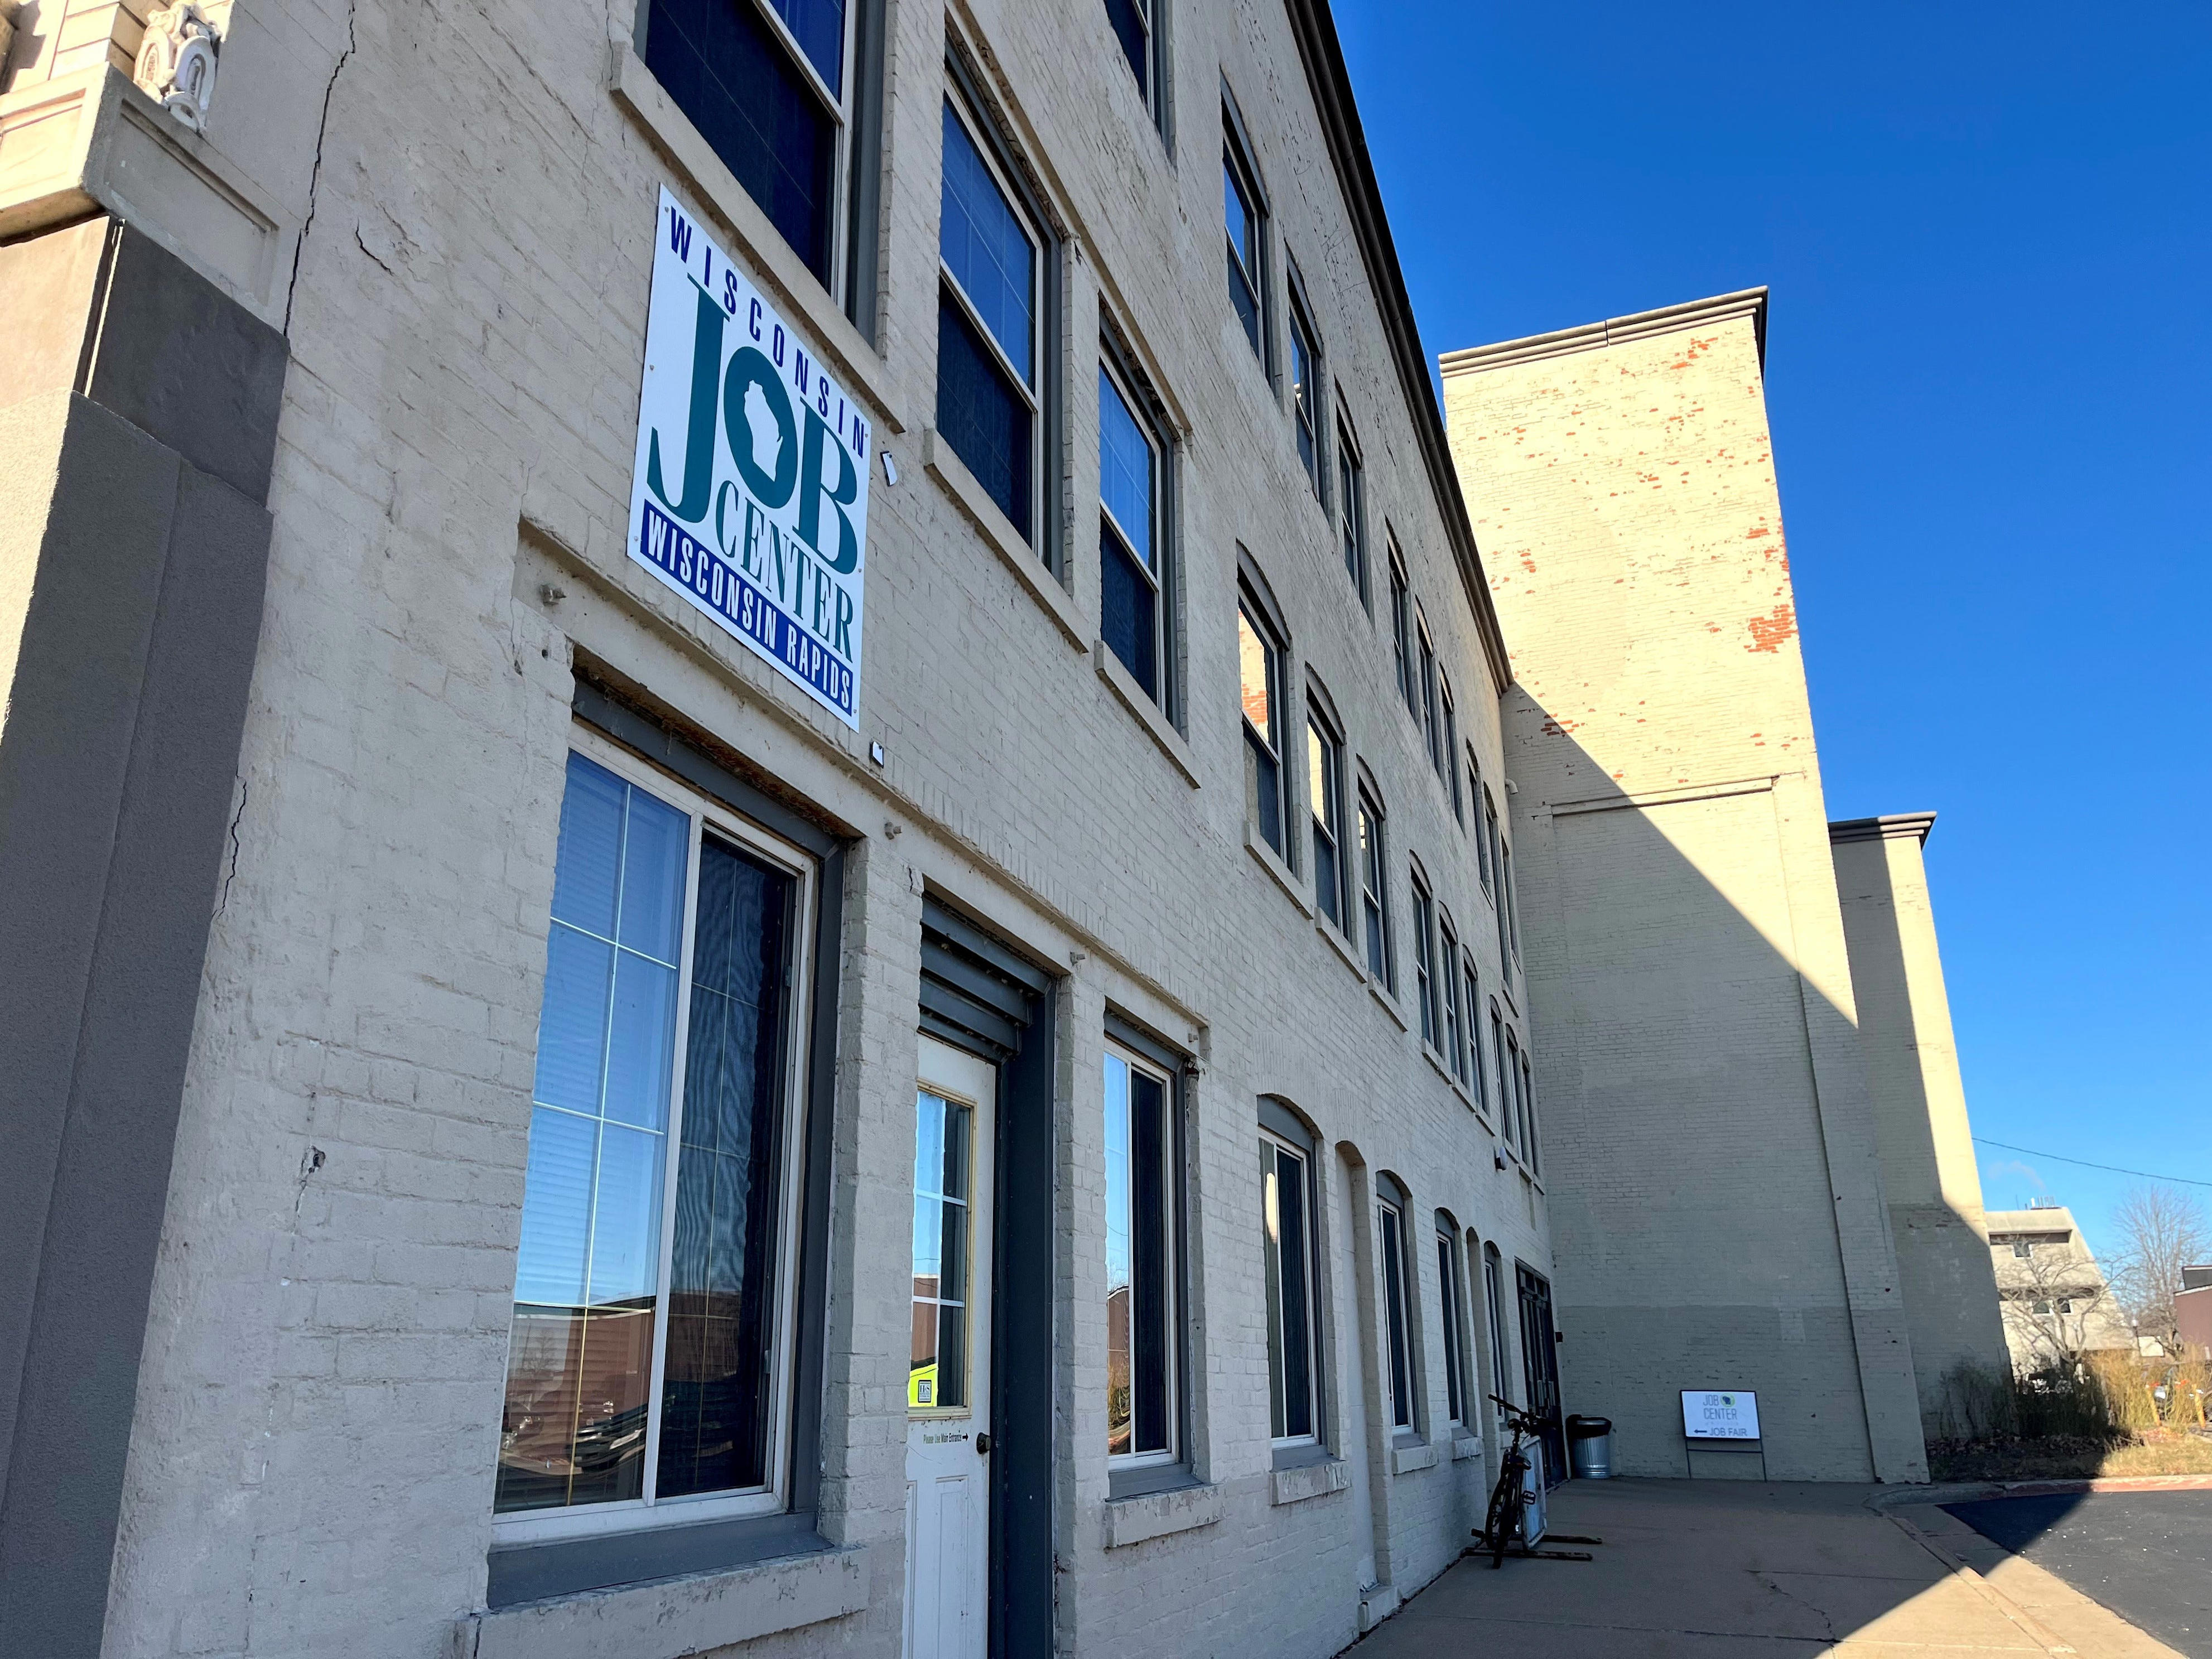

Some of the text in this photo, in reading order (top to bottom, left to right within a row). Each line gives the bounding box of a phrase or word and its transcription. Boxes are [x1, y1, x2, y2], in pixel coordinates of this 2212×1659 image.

[669, 206, 865, 459] WISCONSIN
[647, 273, 857, 575] JOB
[648, 514, 850, 711] WISCONSIN RAPIDS
[715, 480, 853, 664] CENTER
[923, 1434, 934, 1444] Please
[949, 1433, 962, 1443] Entrance
[1703, 1395, 1719, 1406] JOB
[1703, 1408, 1738, 1420] CENTER
[1709, 1427, 1747, 1436] JOB FAIR
